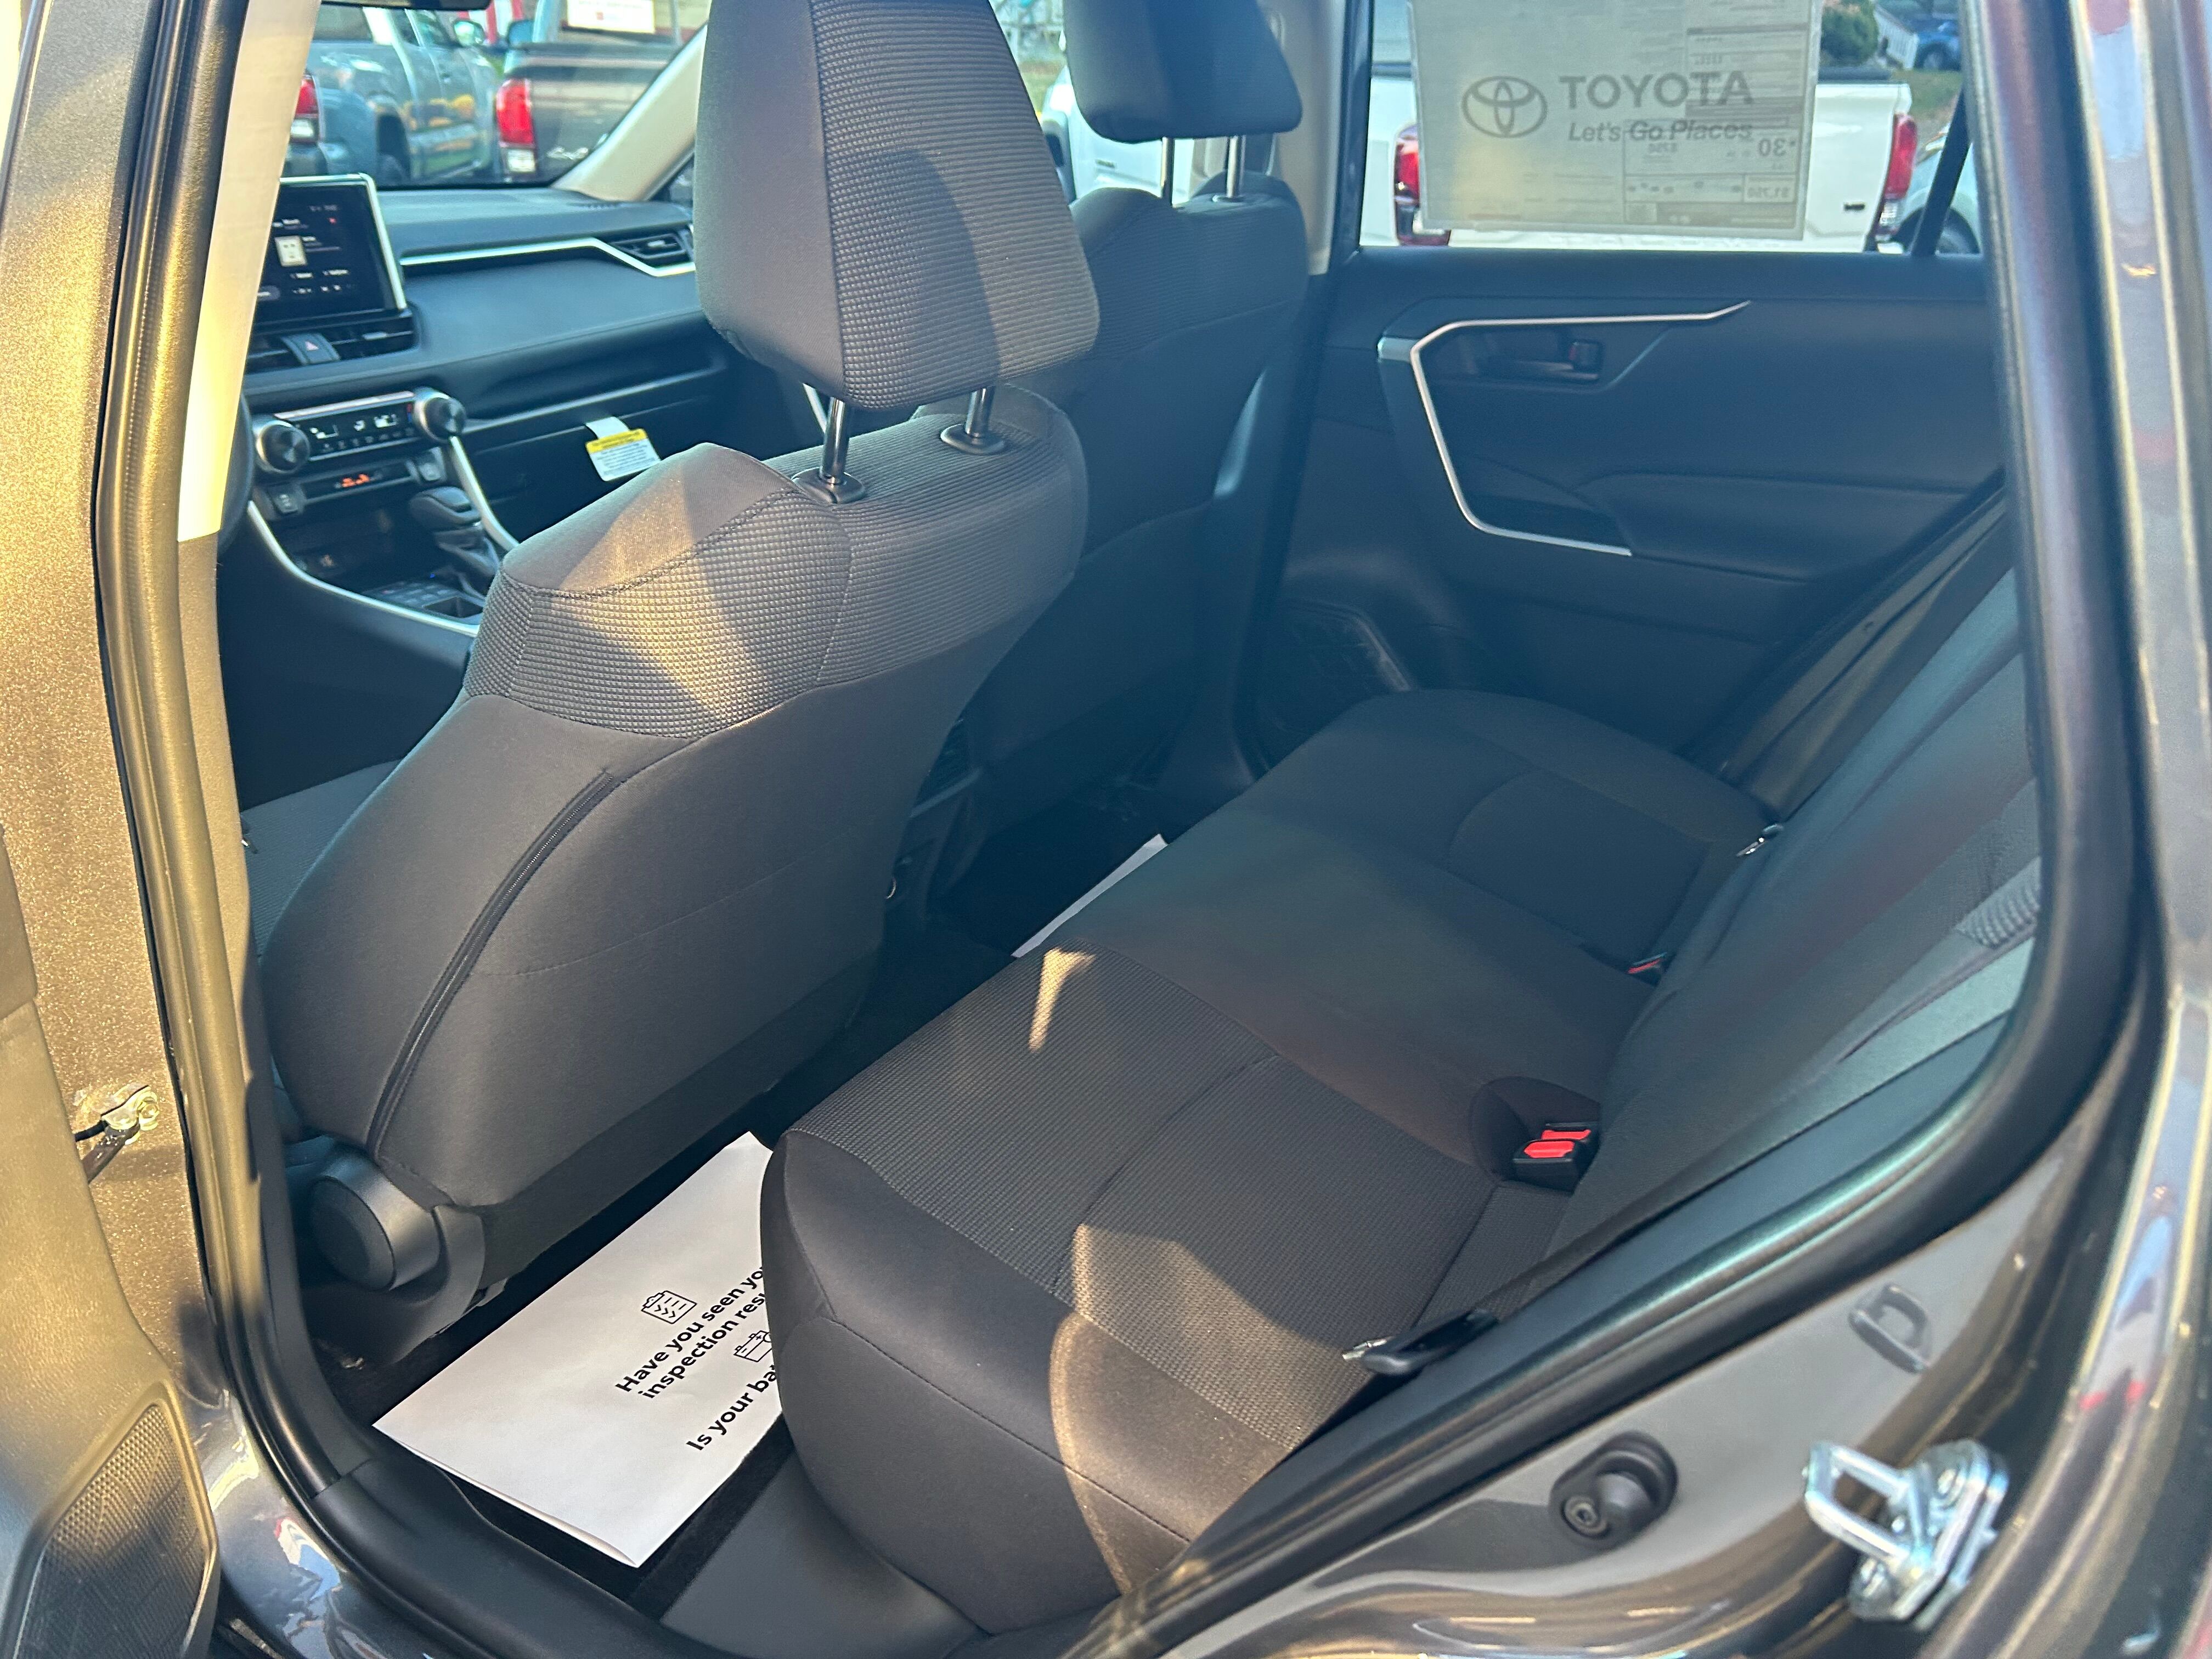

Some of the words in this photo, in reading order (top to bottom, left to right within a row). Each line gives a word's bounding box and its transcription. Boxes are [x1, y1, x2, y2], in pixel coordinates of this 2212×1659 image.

[1559, 70, 1753, 109] TOYOTA
[1568, 122, 1621, 142] Let's
[1630, 120, 1662, 141] Go
[1669, 119, 1753, 141] Places
[616, 1352, 670, 1392] Have
[664, 1322, 704, 1352] you
[701, 1288, 745, 1322] seen
[740, 1267, 763, 1289] yo
[637, 1321, 740, 1398] inspection
[686, 1434, 712, 1451] Is
[708, 1392, 754, 1436] your
